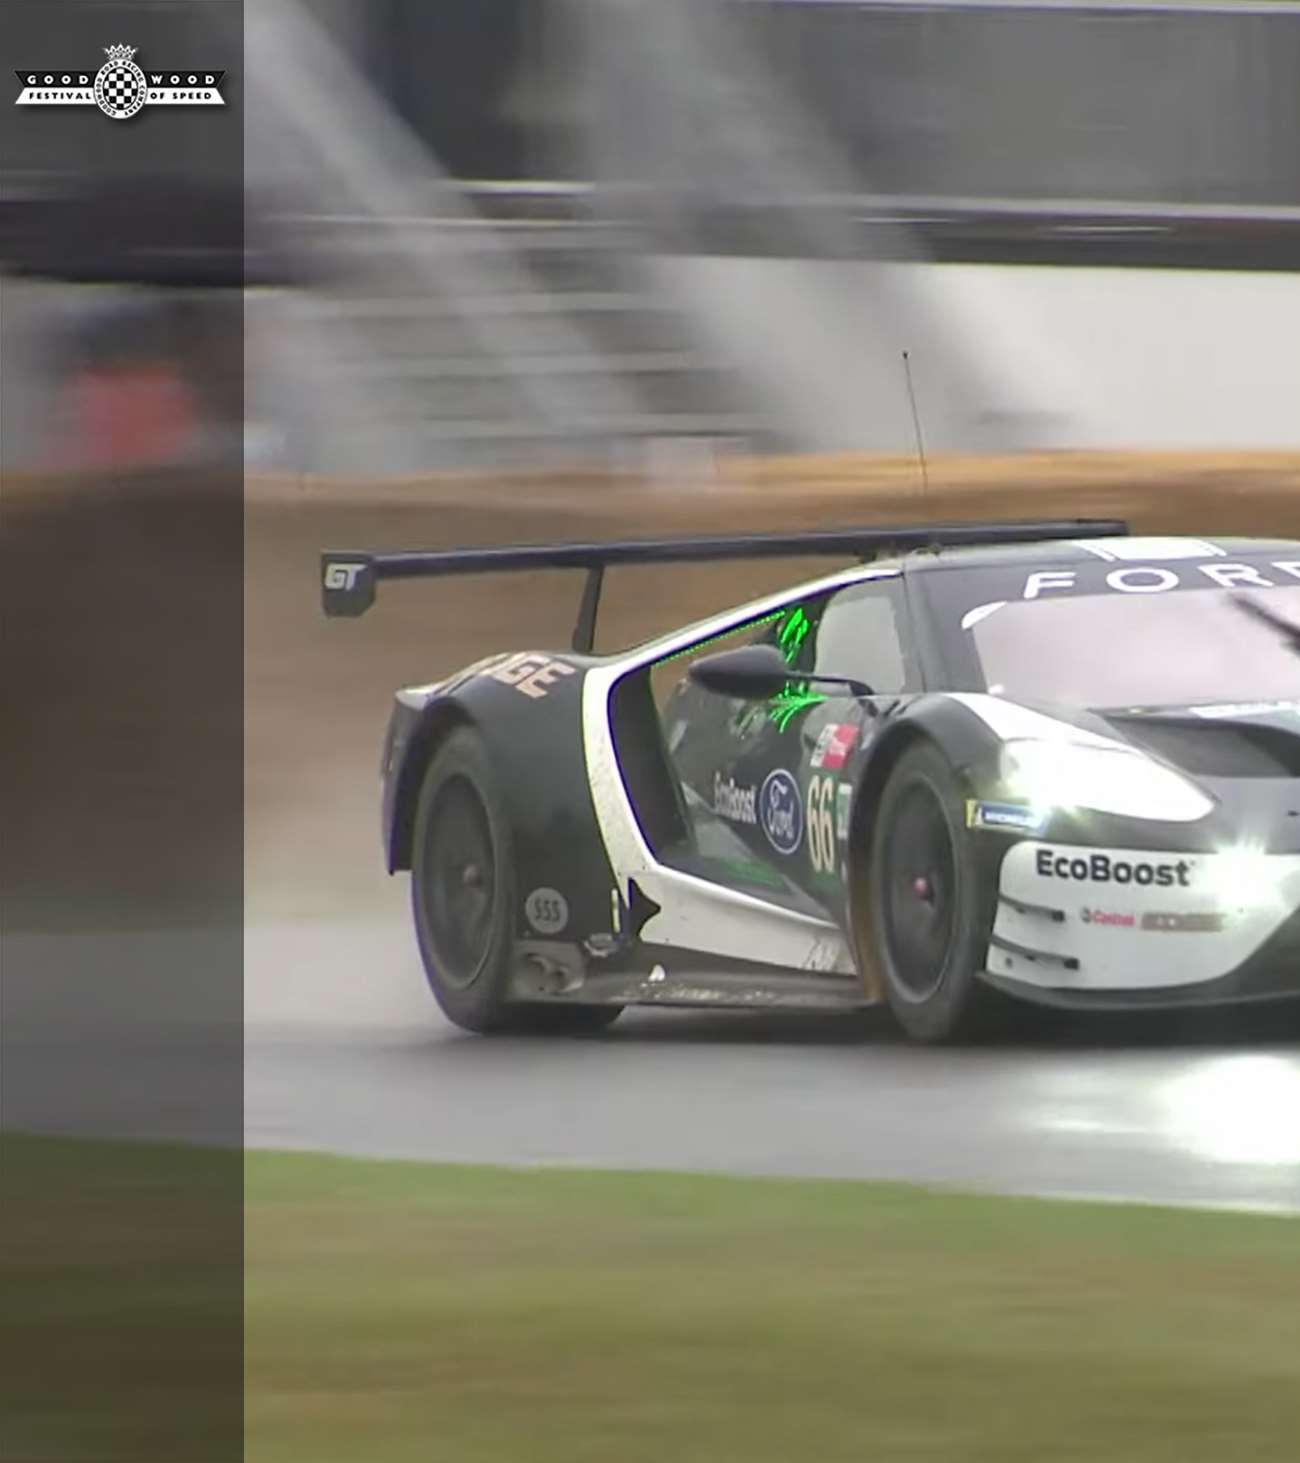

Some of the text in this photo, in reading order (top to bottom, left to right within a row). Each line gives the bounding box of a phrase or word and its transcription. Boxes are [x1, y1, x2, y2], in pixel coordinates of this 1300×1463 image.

[325, 563, 367, 590] GT
[807, 775, 834, 873] 66
[1036, 849, 1190, 887] EcoBoost
